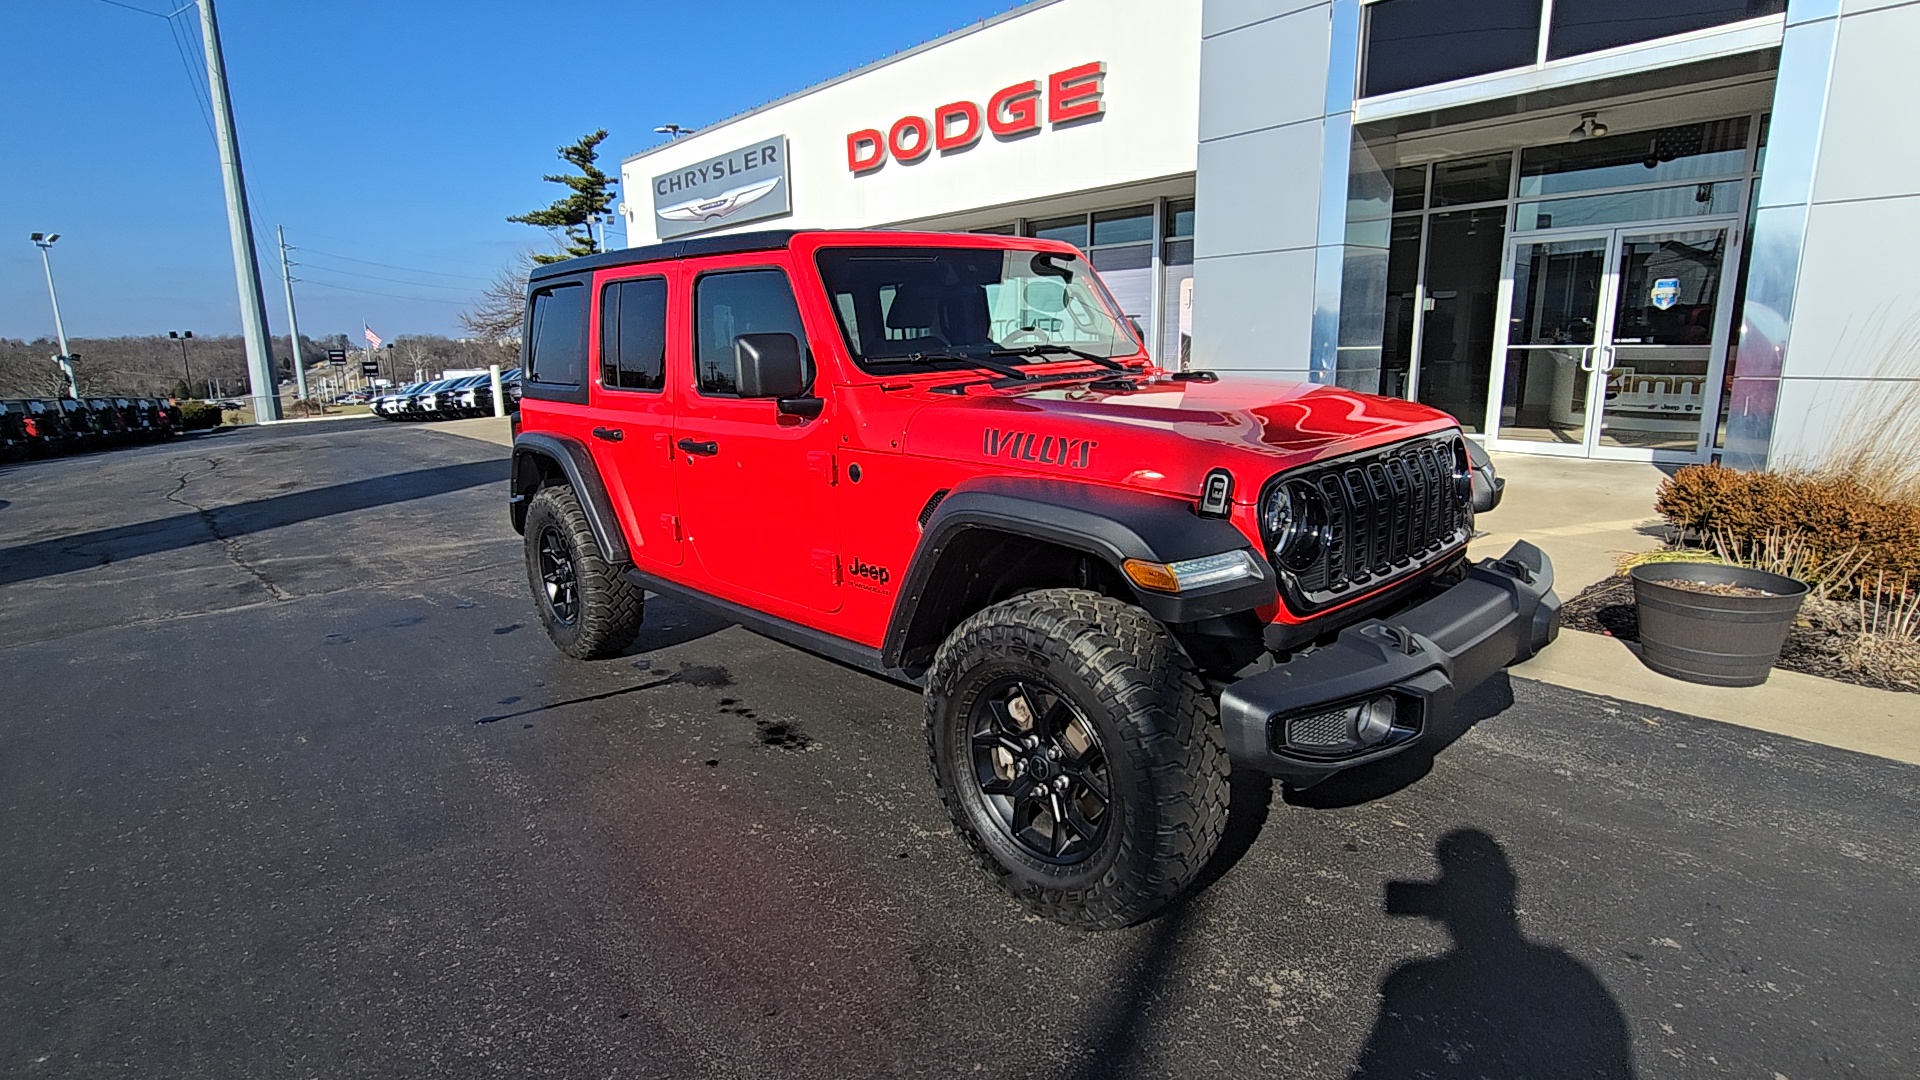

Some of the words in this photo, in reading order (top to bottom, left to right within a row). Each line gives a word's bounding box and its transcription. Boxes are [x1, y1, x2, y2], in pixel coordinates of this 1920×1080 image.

[847, 61, 1106, 172] DODGE
[657, 145, 777, 195] CHRYSLER
[1606, 368, 1707, 396] Zimm
[984, 428, 1098, 468] WILLYS
[849, 556, 890, 585] Jeep
